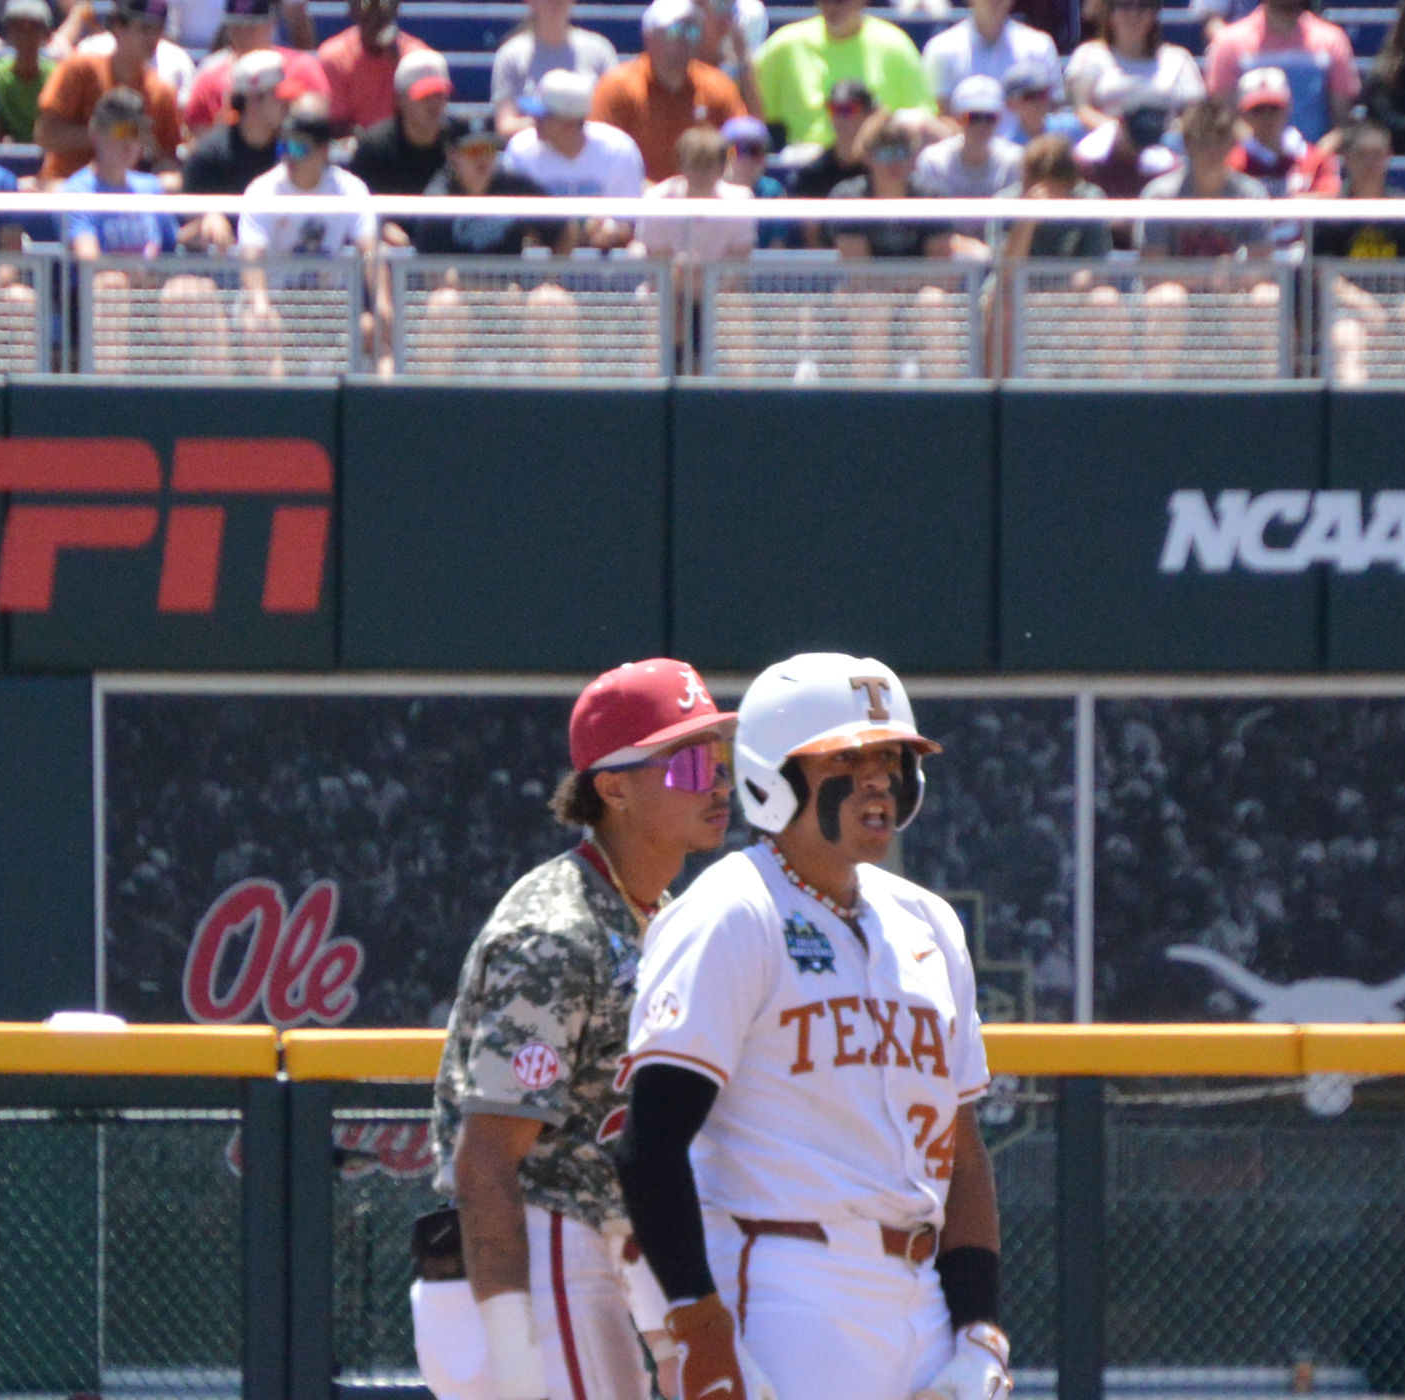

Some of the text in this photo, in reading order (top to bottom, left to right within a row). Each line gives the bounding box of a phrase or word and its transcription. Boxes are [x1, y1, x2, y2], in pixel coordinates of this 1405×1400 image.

[849, 676, 890, 720] T
[182, 877, 364, 1028] Ole
[515, 1045, 558, 1087] SEC
[779, 996, 955, 1078] TEXA
